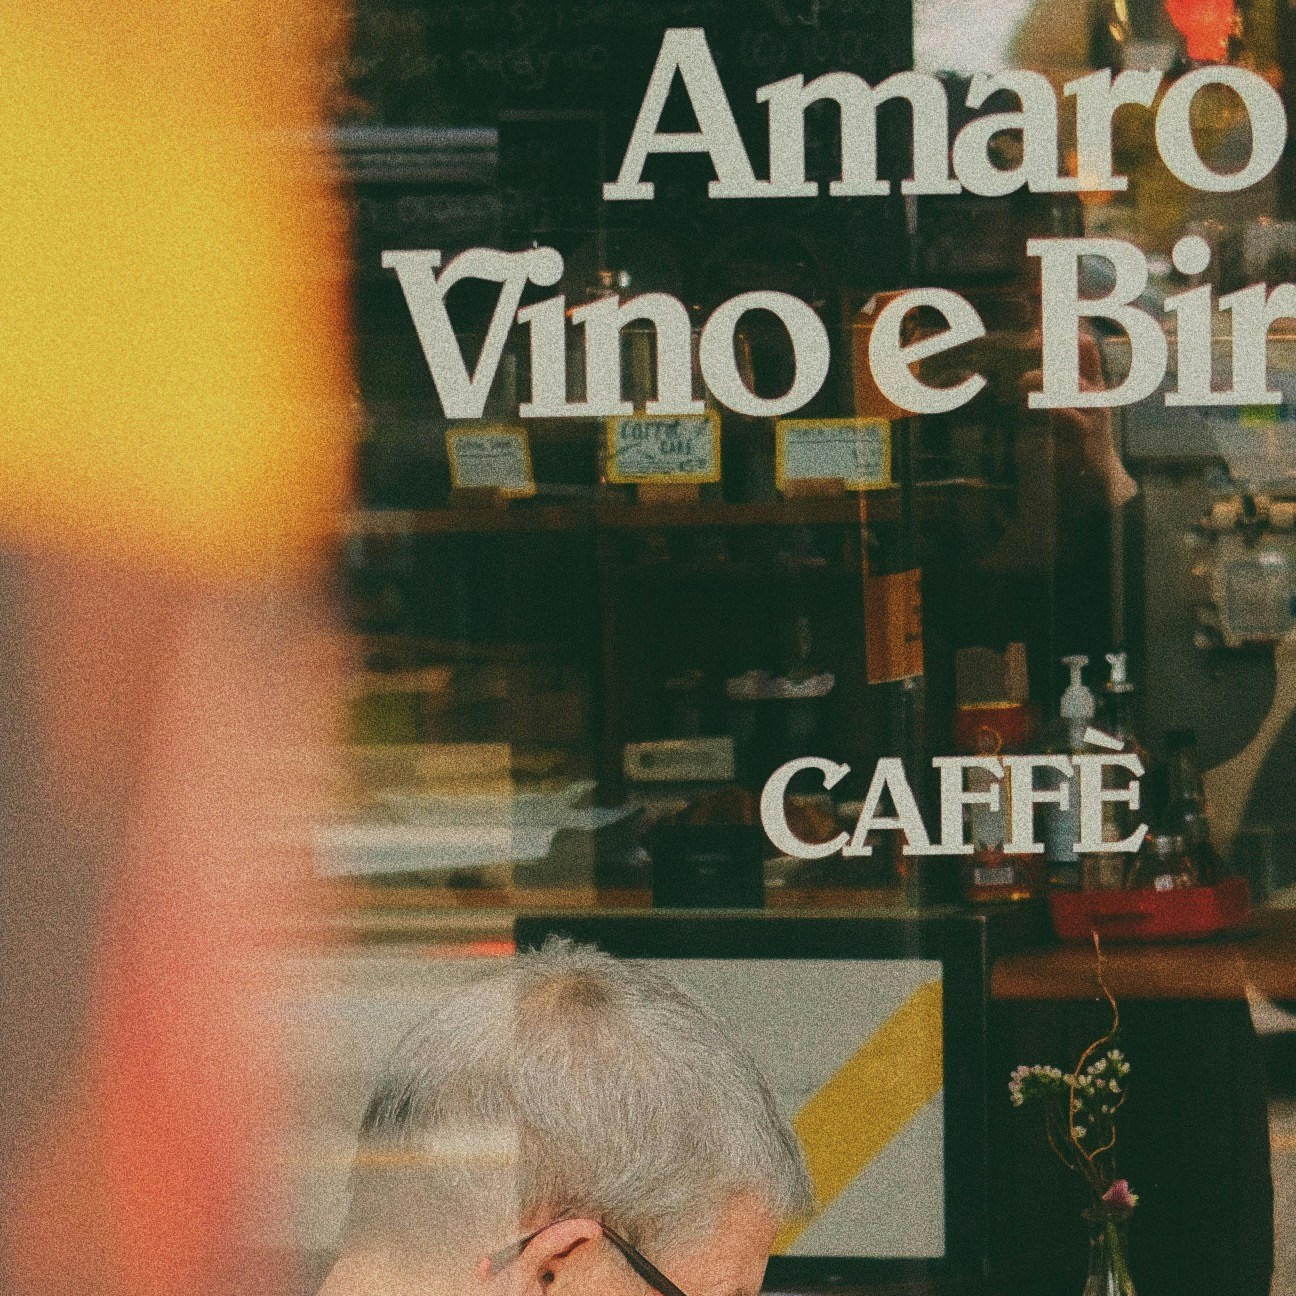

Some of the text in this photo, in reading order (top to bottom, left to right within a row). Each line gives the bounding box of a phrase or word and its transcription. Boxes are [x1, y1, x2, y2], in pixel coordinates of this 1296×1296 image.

[603, 27, 1287, 199] Amaro
[382, 245, 830, 418] Vino
[868, 287, 988, 414] e
[760, 725, 1149, 859] CAFFÈ
